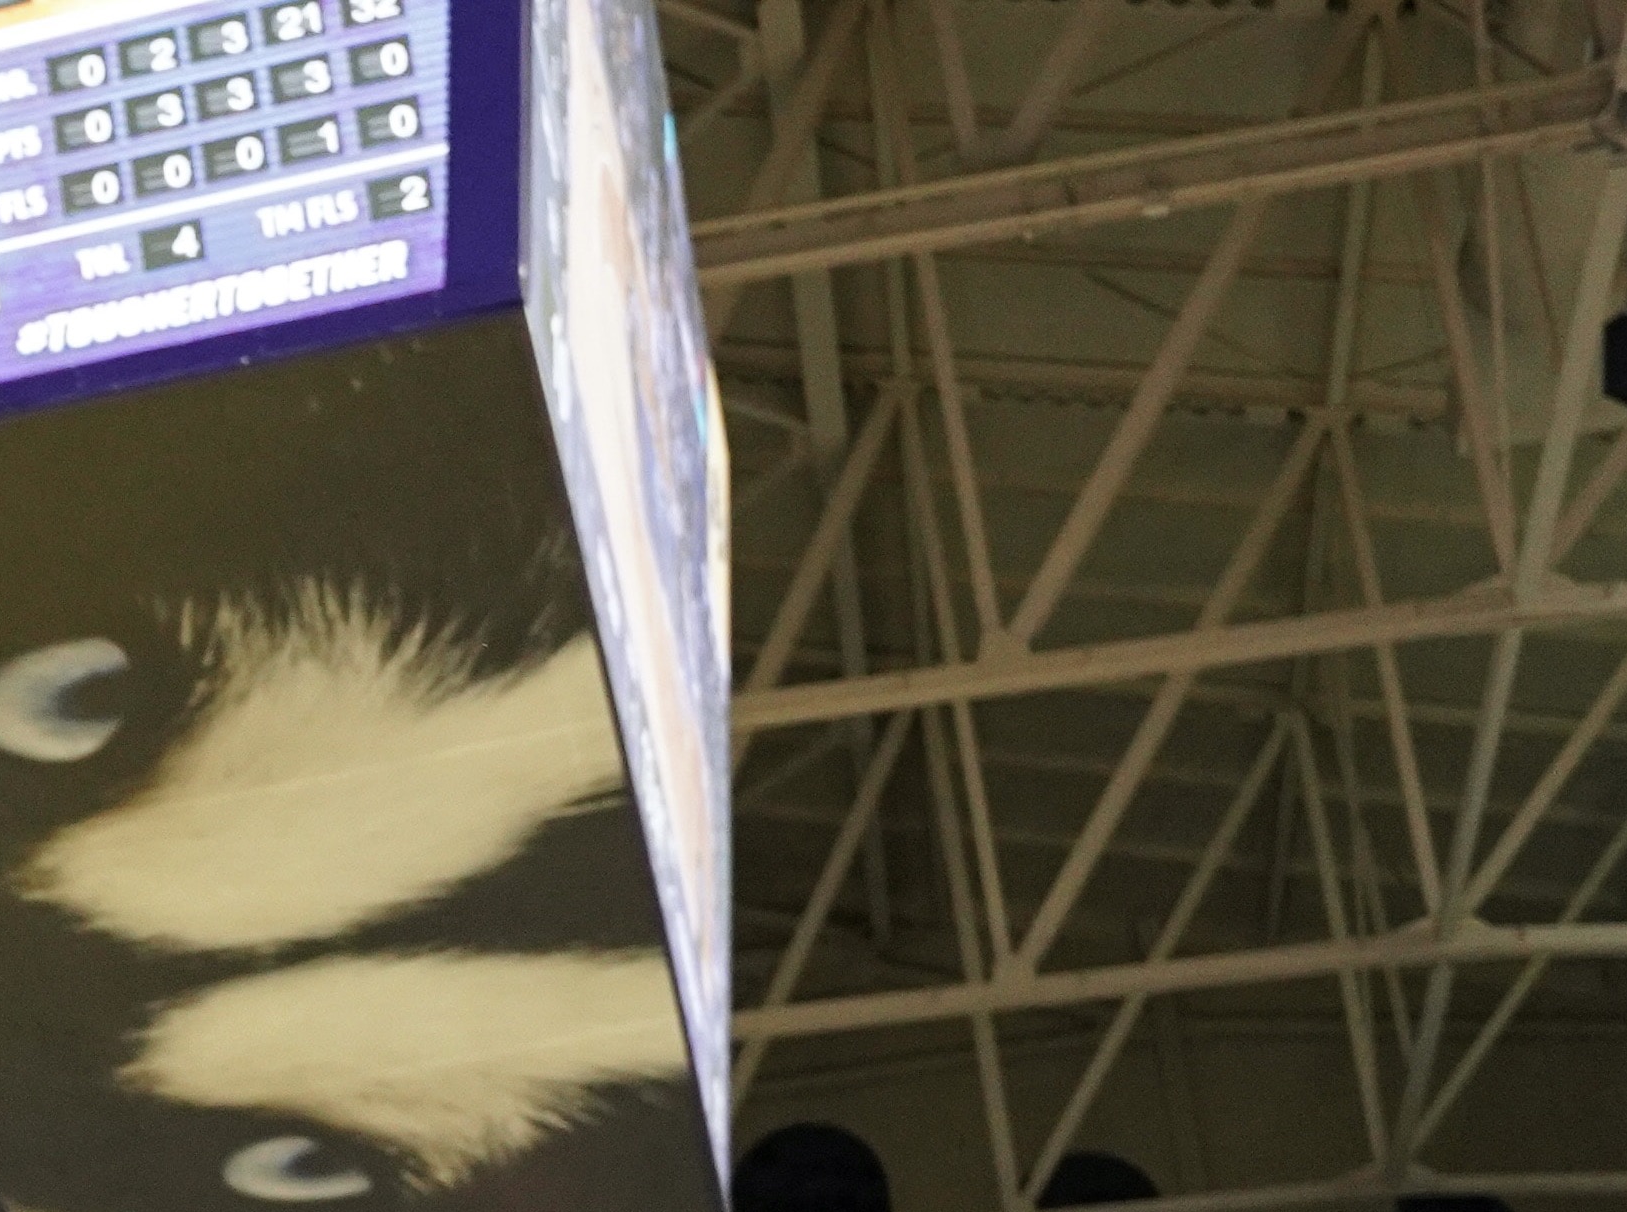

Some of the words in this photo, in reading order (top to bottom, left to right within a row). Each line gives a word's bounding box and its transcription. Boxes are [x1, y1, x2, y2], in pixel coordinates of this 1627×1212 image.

[78, 53, 107, 88] 0
[149, 38, 176, 72] 2
[220, 20, 248, 54] 3
[276, 6, 323, 41] 21
[84, 109, 113, 143] 0
[156, 93, 184, 127] 3
[226, 77, 254, 111] 3
[303, 60, 331, 93] 3
[379, 42, 409, 76] 0
[91, 170, 120, 204] 0
[163, 154, 192, 188] 0
[235, 136, 264, 171] 0
[318, 121, 339, 154] 1
[388, 104, 418, 138] 0
[172, 225, 200, 258] 4
[399, 175, 428, 212] 2
